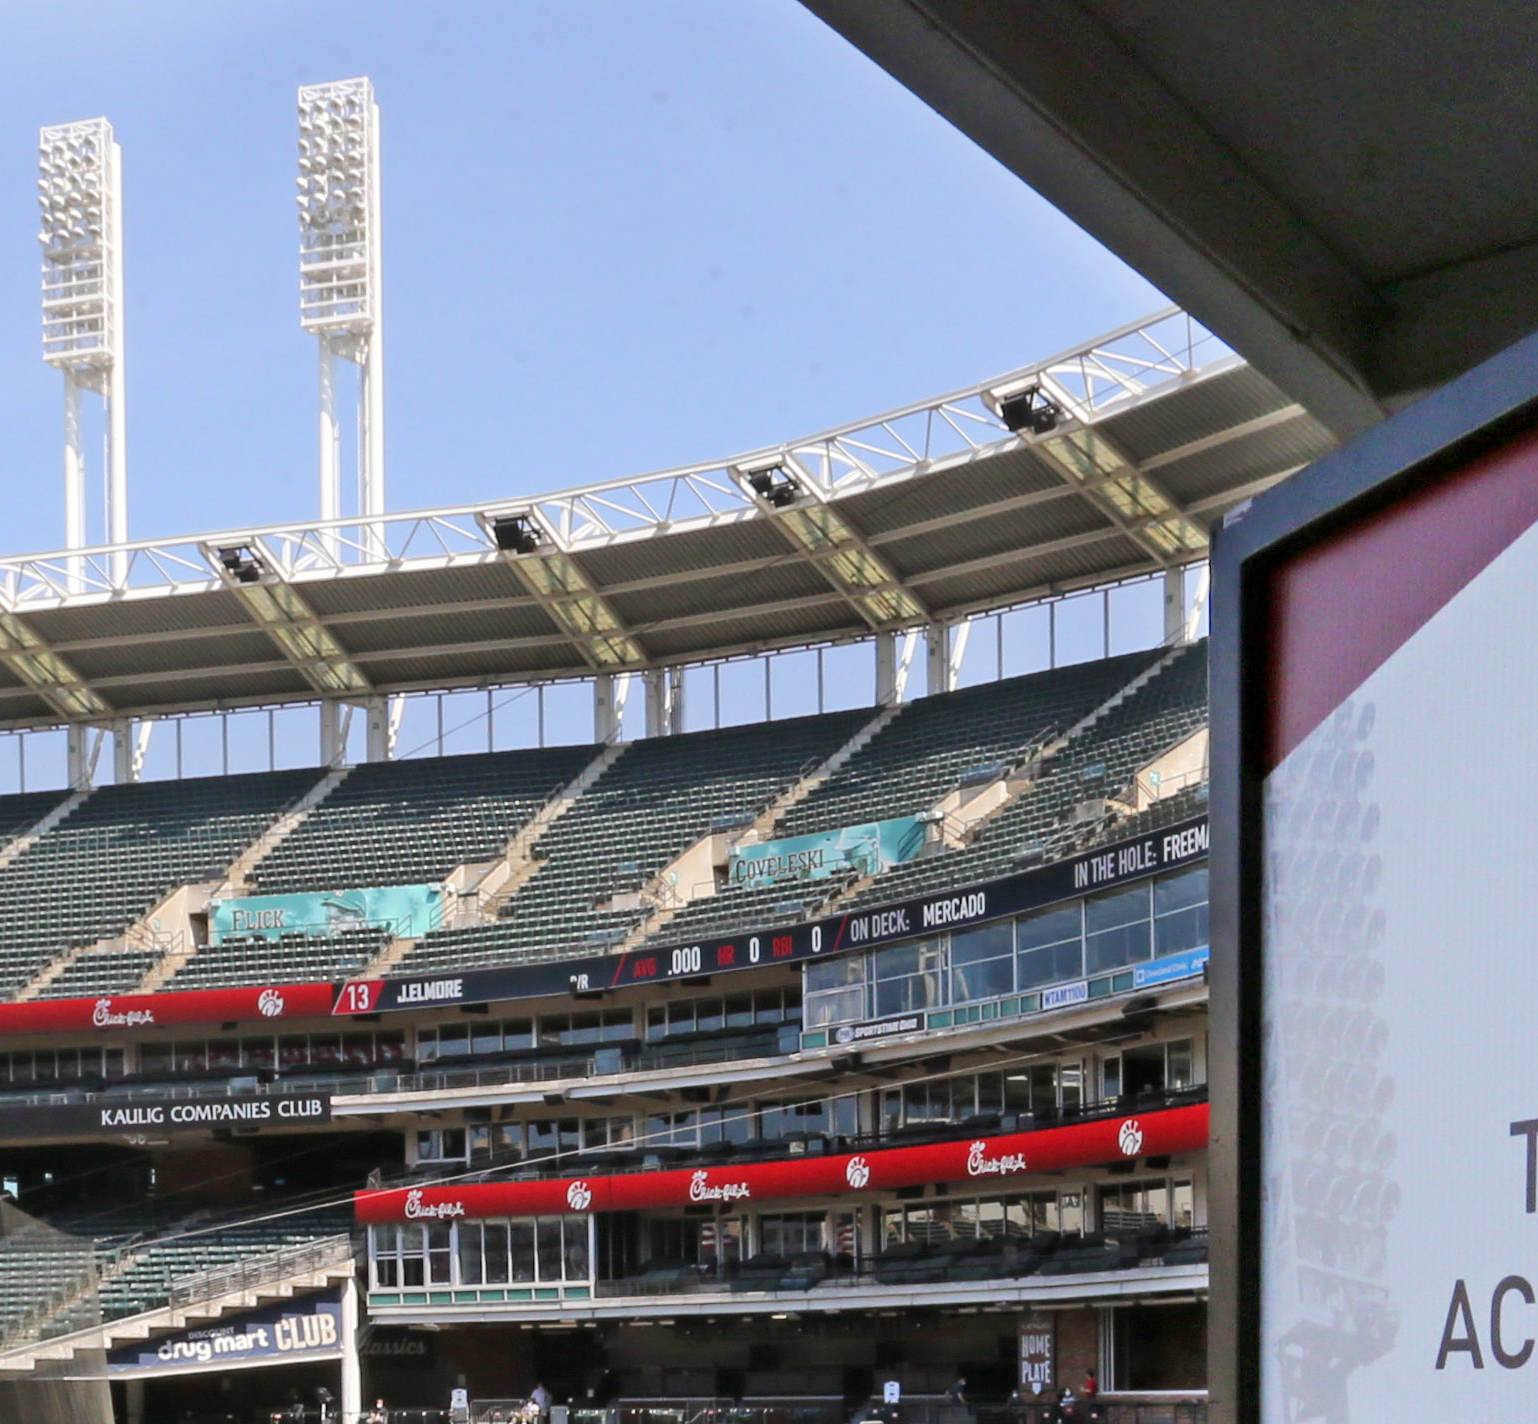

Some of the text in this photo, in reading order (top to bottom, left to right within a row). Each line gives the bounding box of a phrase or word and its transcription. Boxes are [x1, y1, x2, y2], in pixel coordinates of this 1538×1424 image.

[736, 849, 824, 883] COVELESKI
[1074, 861, 1089, 888] IN
[1091, 853, 1115, 883] THE
[1119, 841, 1157, 875] HOLE:
[231, 909, 285, 931] FLICK
[851, 892, 985, 942] ON DECK: MERCADO
[347, 984, 369, 1010] 13
[634, 957, 656, 978] AVG
[668, 946, 701, 975] .000
[717, 945, 735, 966] HR
[749, 937, 759, 962] 0
[772, 936, 793, 957] RBI
[811, 926, 821, 952] 0
[101, 1099, 322, 1126] KAULIG COMPANIES CLUB
[157, 1313, 338, 1361] drug mart CLUB
[1022, 1334, 1050, 1357] HOME
[1022, 1361, 1051, 1384] PLATE
